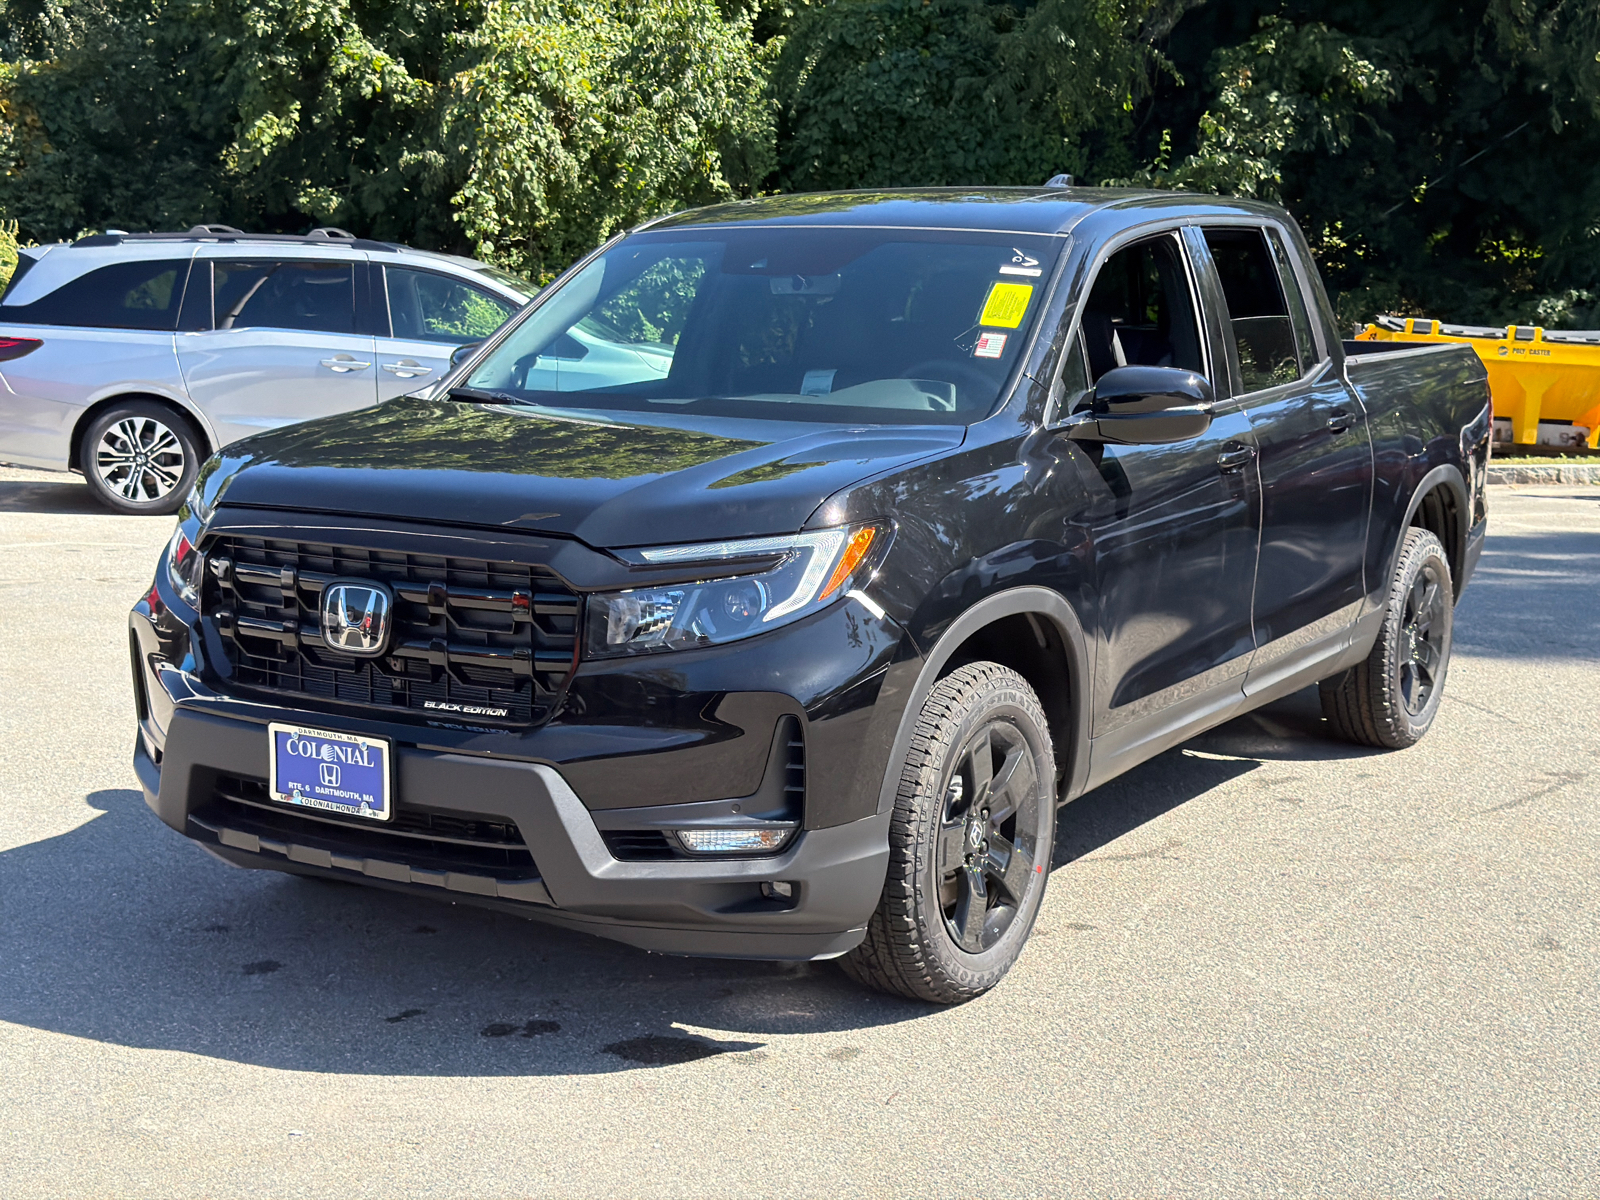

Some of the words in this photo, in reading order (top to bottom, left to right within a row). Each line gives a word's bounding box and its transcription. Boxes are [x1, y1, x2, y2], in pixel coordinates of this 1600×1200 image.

[423, 700, 463, 712] BLACK
[462, 704, 508, 717] EDITION
[286, 738, 374, 768] COLONIAL
[304, 784, 311, 792] 6
[362, 793, 375, 803] MA
